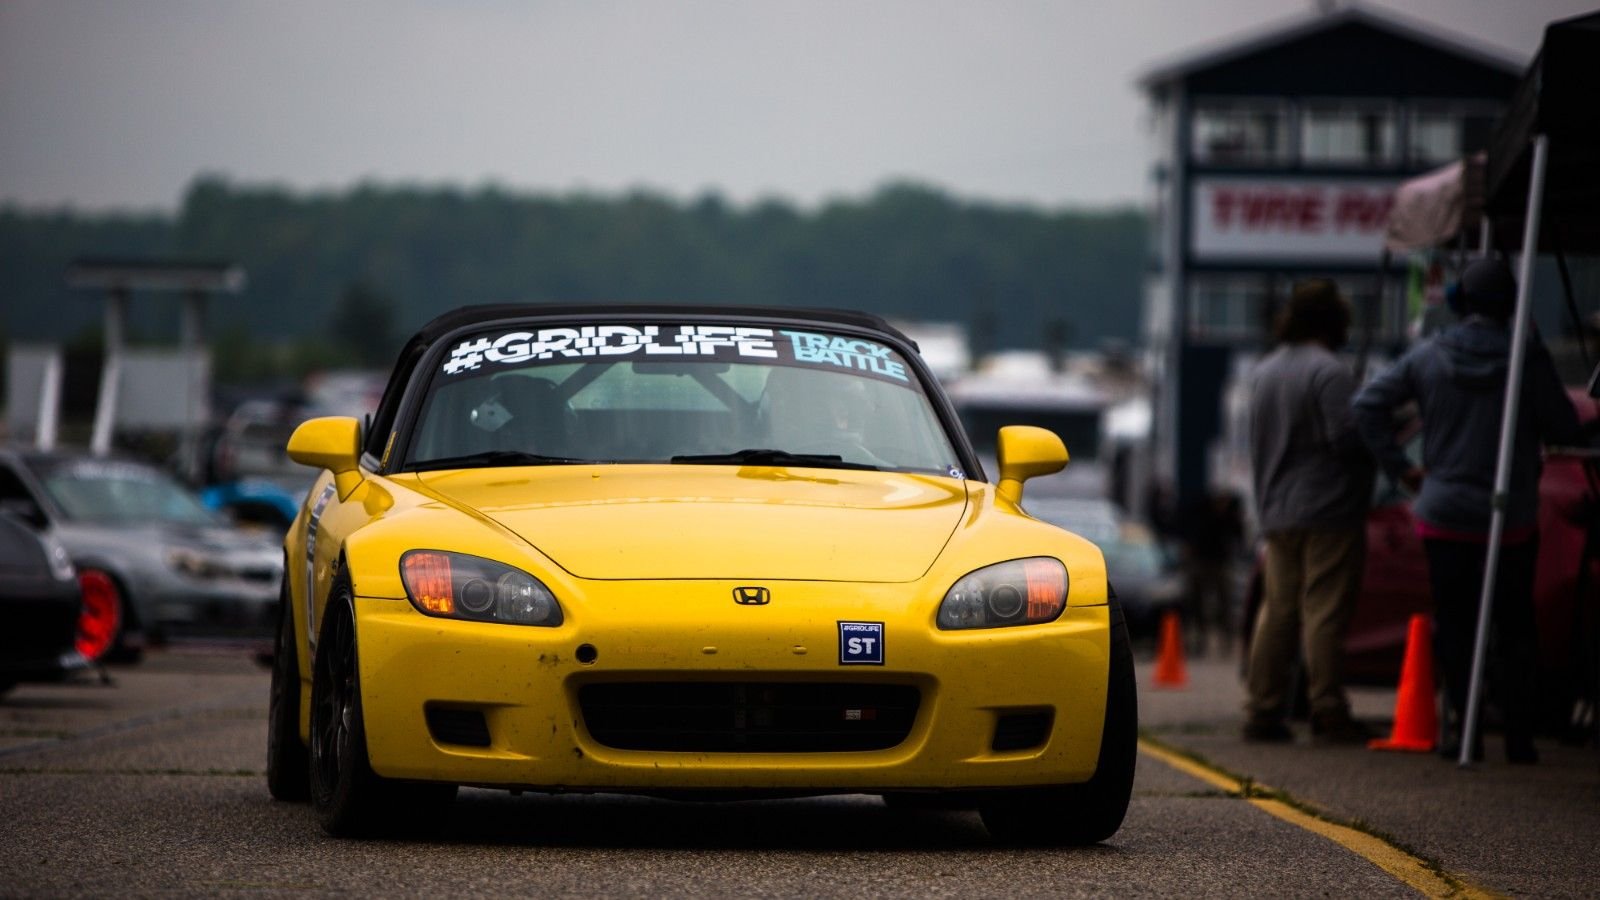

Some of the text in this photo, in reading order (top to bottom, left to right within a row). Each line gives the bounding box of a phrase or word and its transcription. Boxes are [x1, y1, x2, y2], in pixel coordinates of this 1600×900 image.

[443, 325, 778, 374] #GRIDLIFE
[779, 330, 891, 359] TRACK
[794, 346, 909, 381] BATTLE
[847, 637, 876, 654] ST
